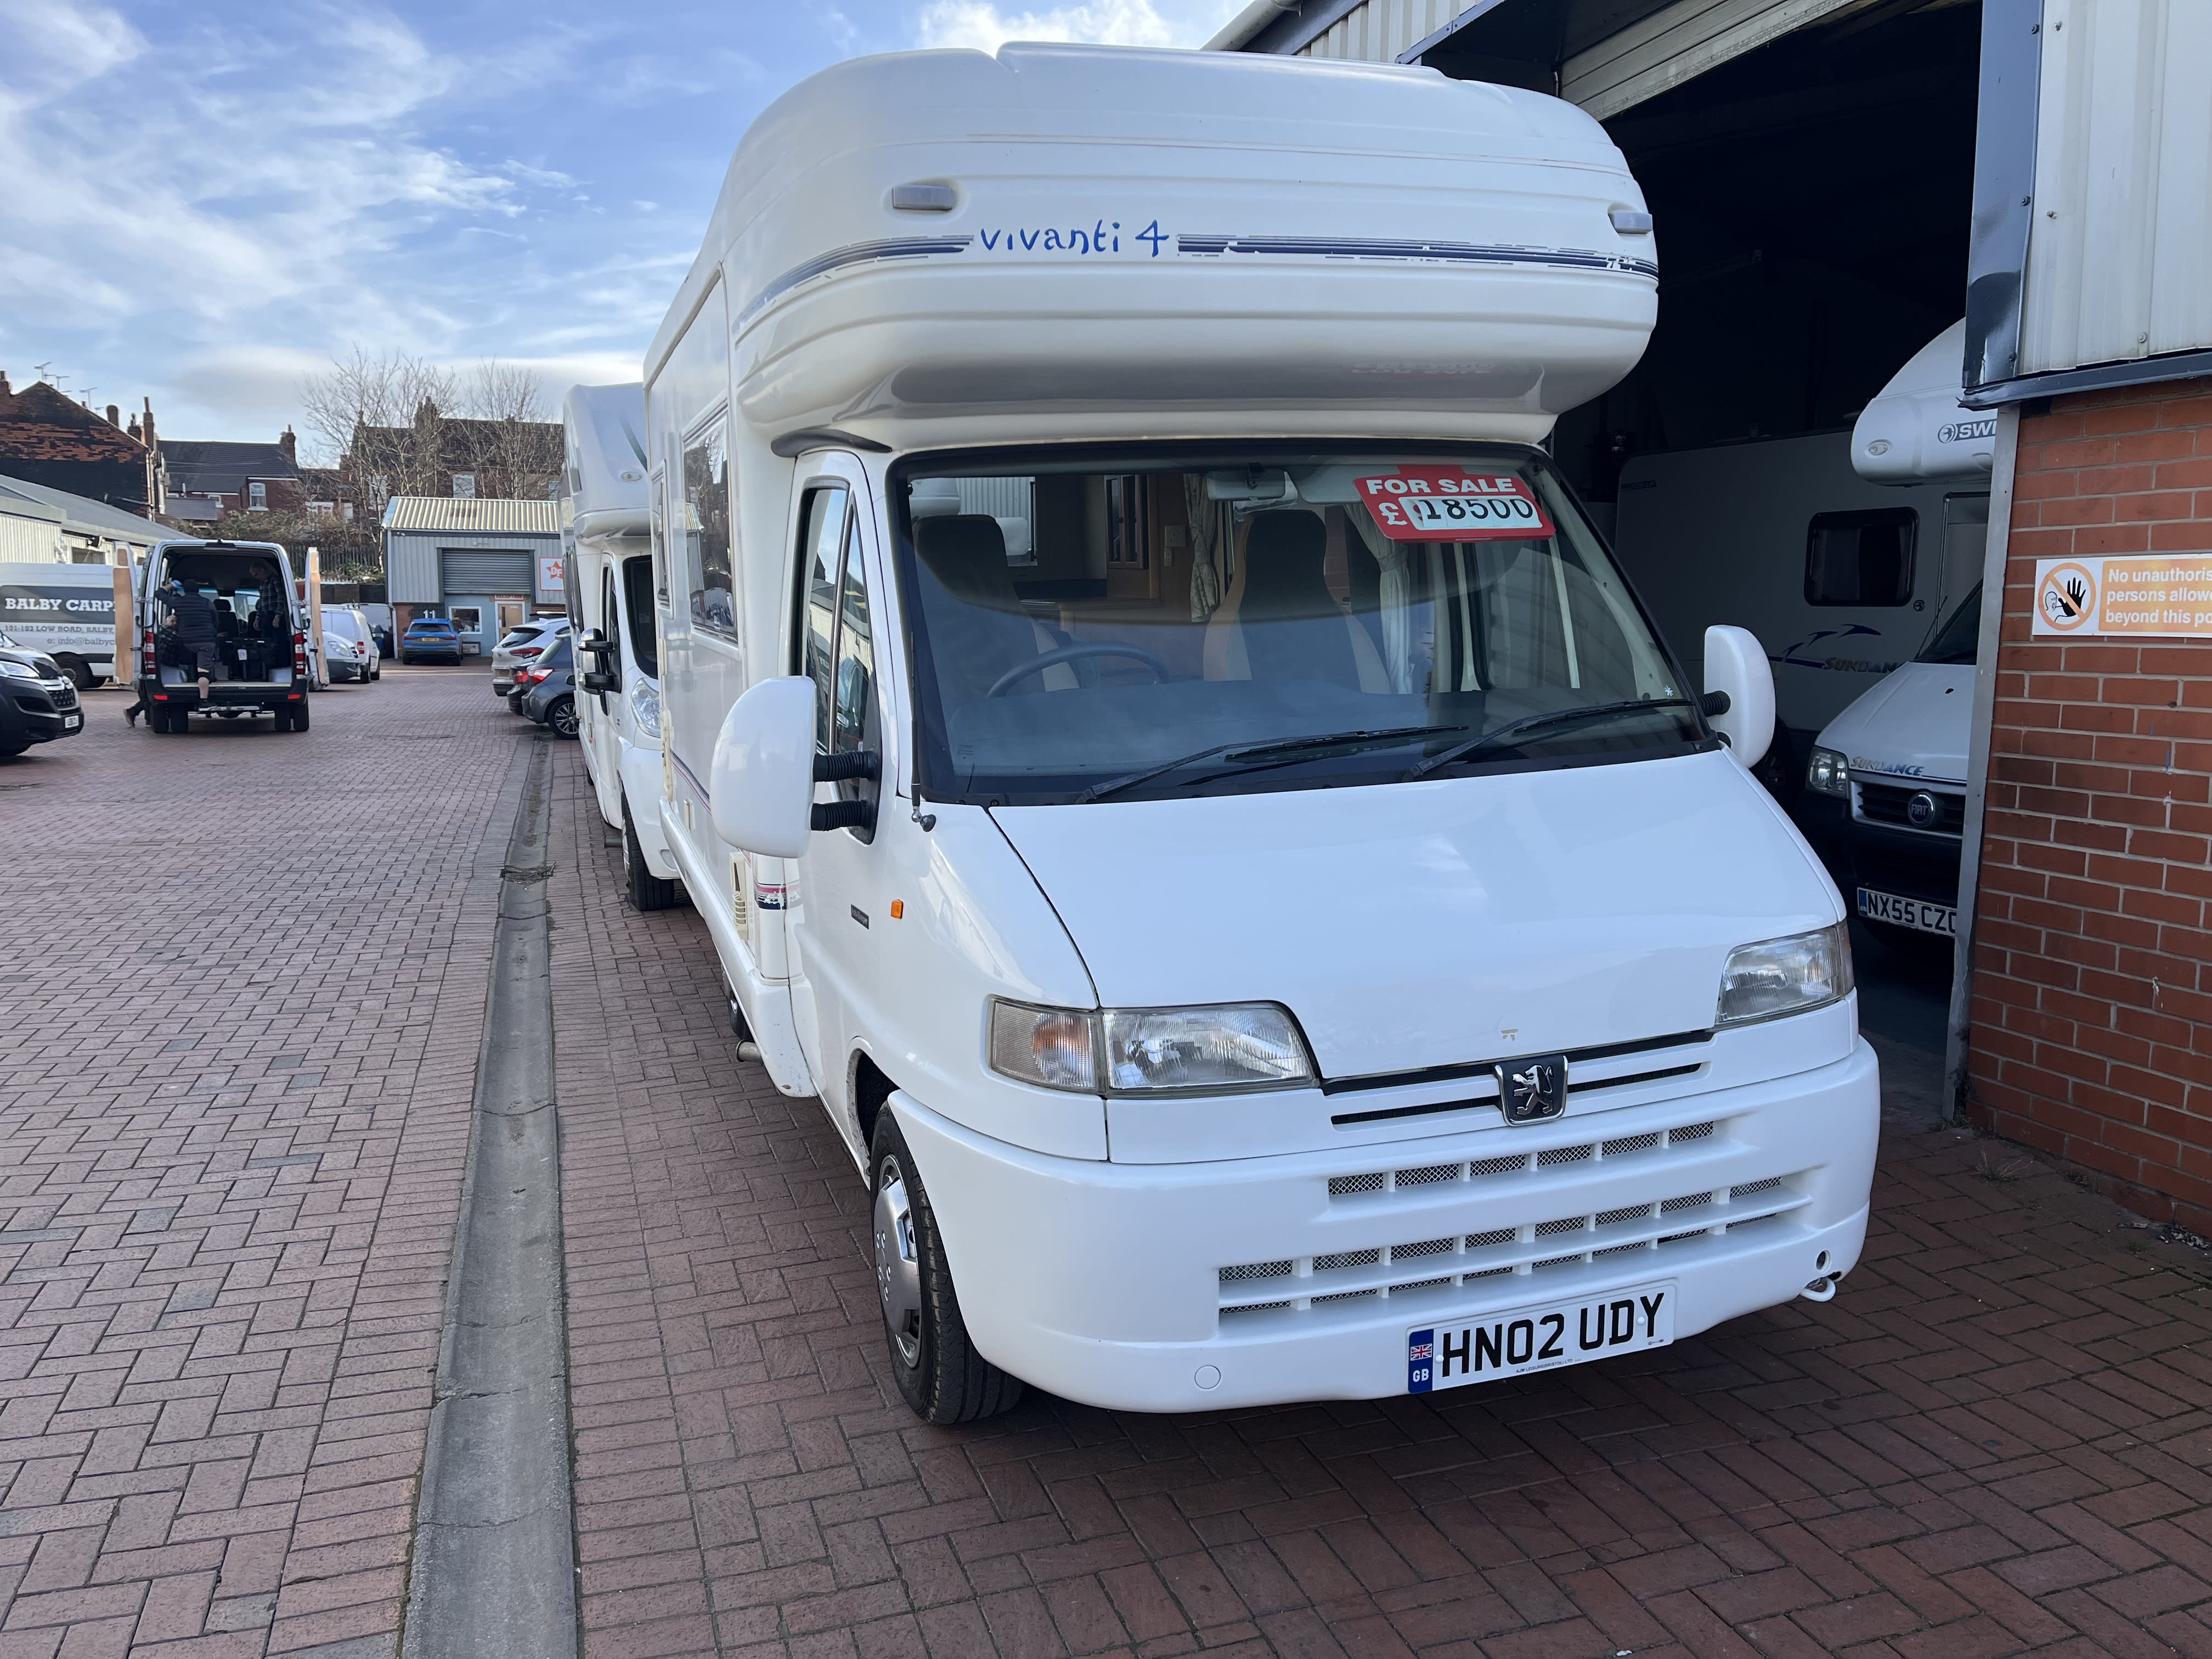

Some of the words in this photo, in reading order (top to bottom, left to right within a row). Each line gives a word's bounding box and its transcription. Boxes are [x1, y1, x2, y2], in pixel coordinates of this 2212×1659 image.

[980, 219, 1120, 255] vivanti
[1135, 219, 1170, 257] 4
[1959, 421, 1997, 438] SWI
[1366, 479, 1431, 494] FOR
[1438, 478, 1516, 493] SALE
[1379, 502, 1408, 525] £
[1419, 499, 1533, 520] 18500
[2108, 568, 2129, 582] No
[2132, 567, 2212, 582] unauthoris
[5, 597, 62, 610] BALBY
[65, 599, 115, 612] CARP
[2107, 590, 2166, 605] persons
[2169, 587, 2212, 602] allow
[423, 610, 435, 618] 11
[2106, 609, 2159, 626] beyond
[2163, 608, 2191, 623] this
[2194, 612, 2212, 627] po
[1851, 756, 1924, 776] SUNDANCE
[1911, 804, 1927, 816] FIAT
[1868, 893, 1915, 924] NX55
[1442, 1313, 1564, 1378] HN02
[1579, 1293, 1664, 1351] UDY
[1413, 1368, 1429, 1383] GB
